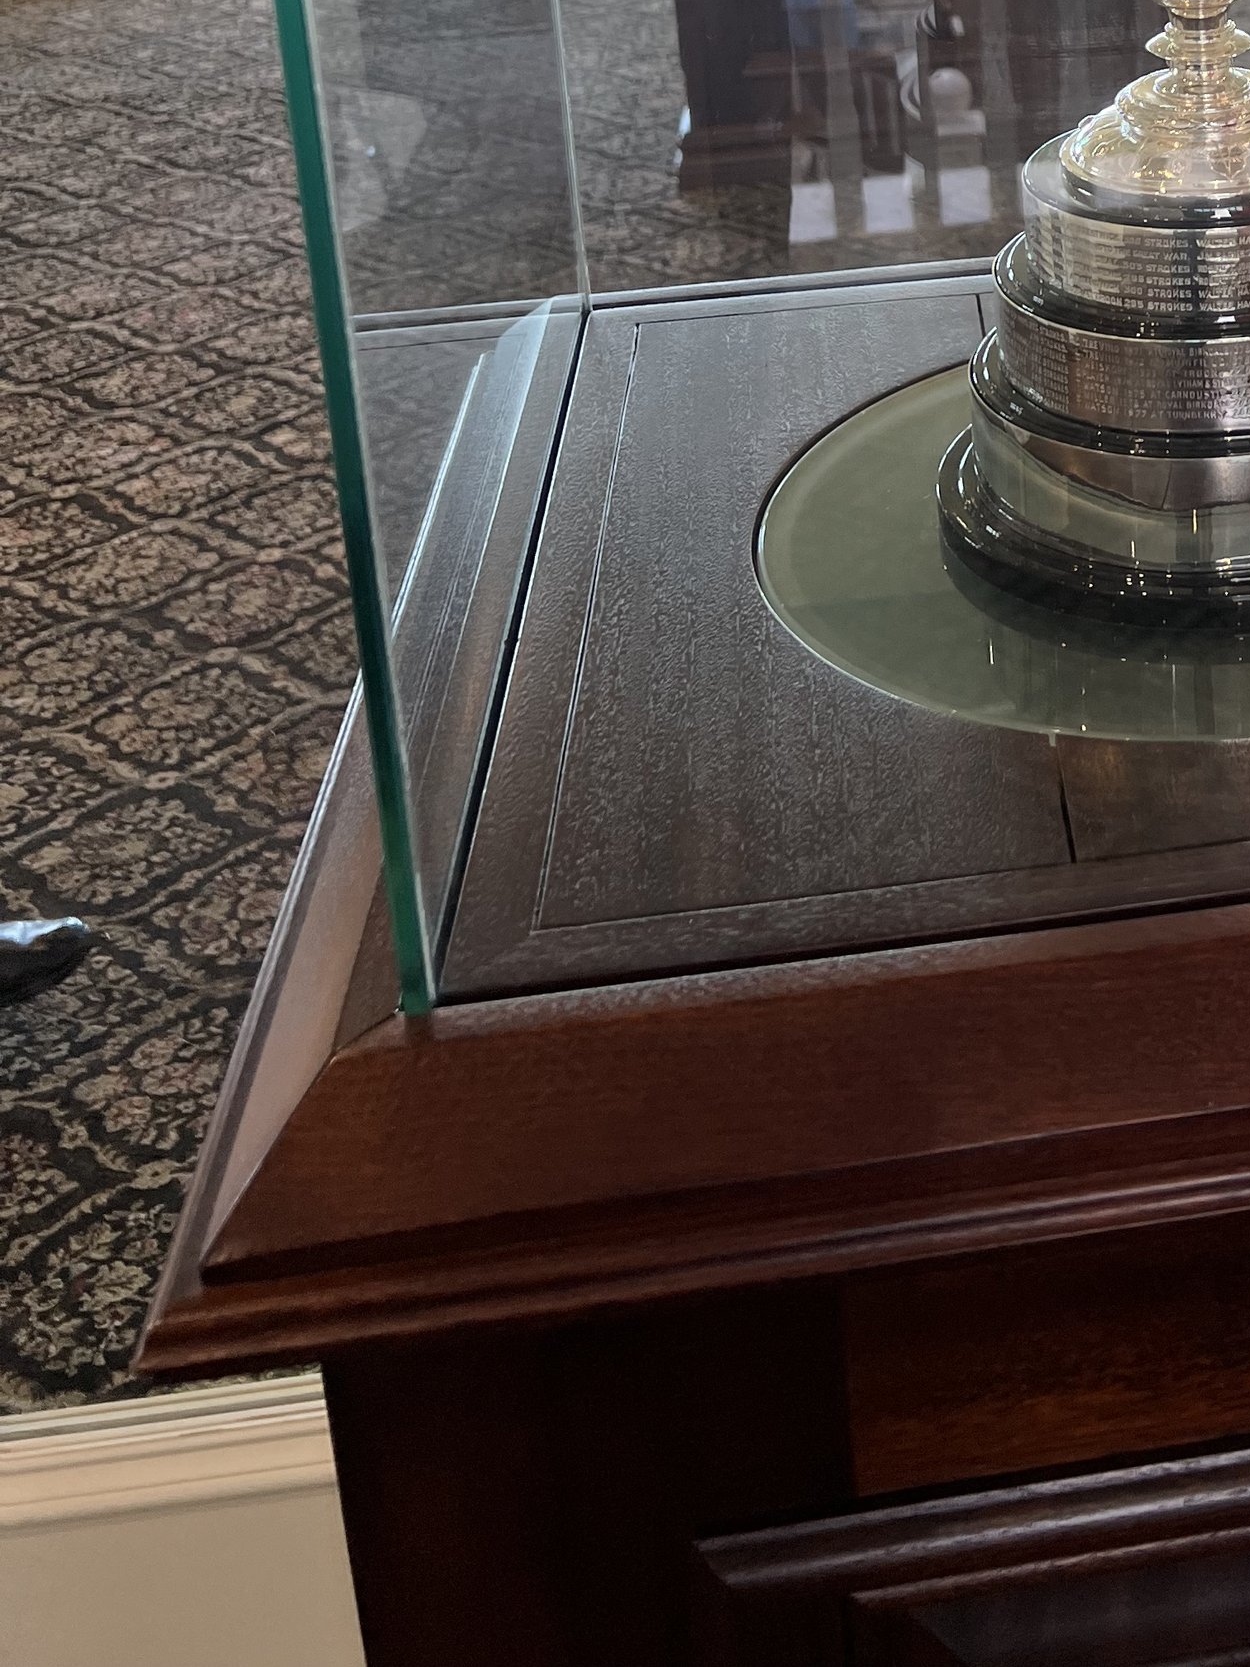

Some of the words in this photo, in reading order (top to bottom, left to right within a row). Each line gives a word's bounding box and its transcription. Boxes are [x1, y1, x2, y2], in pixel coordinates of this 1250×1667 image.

[1123, 298, 1145, 309] 25
[1147, 301, 1193, 312] STROKES
[1165, 390, 1226, 400] CARNOUSTI
